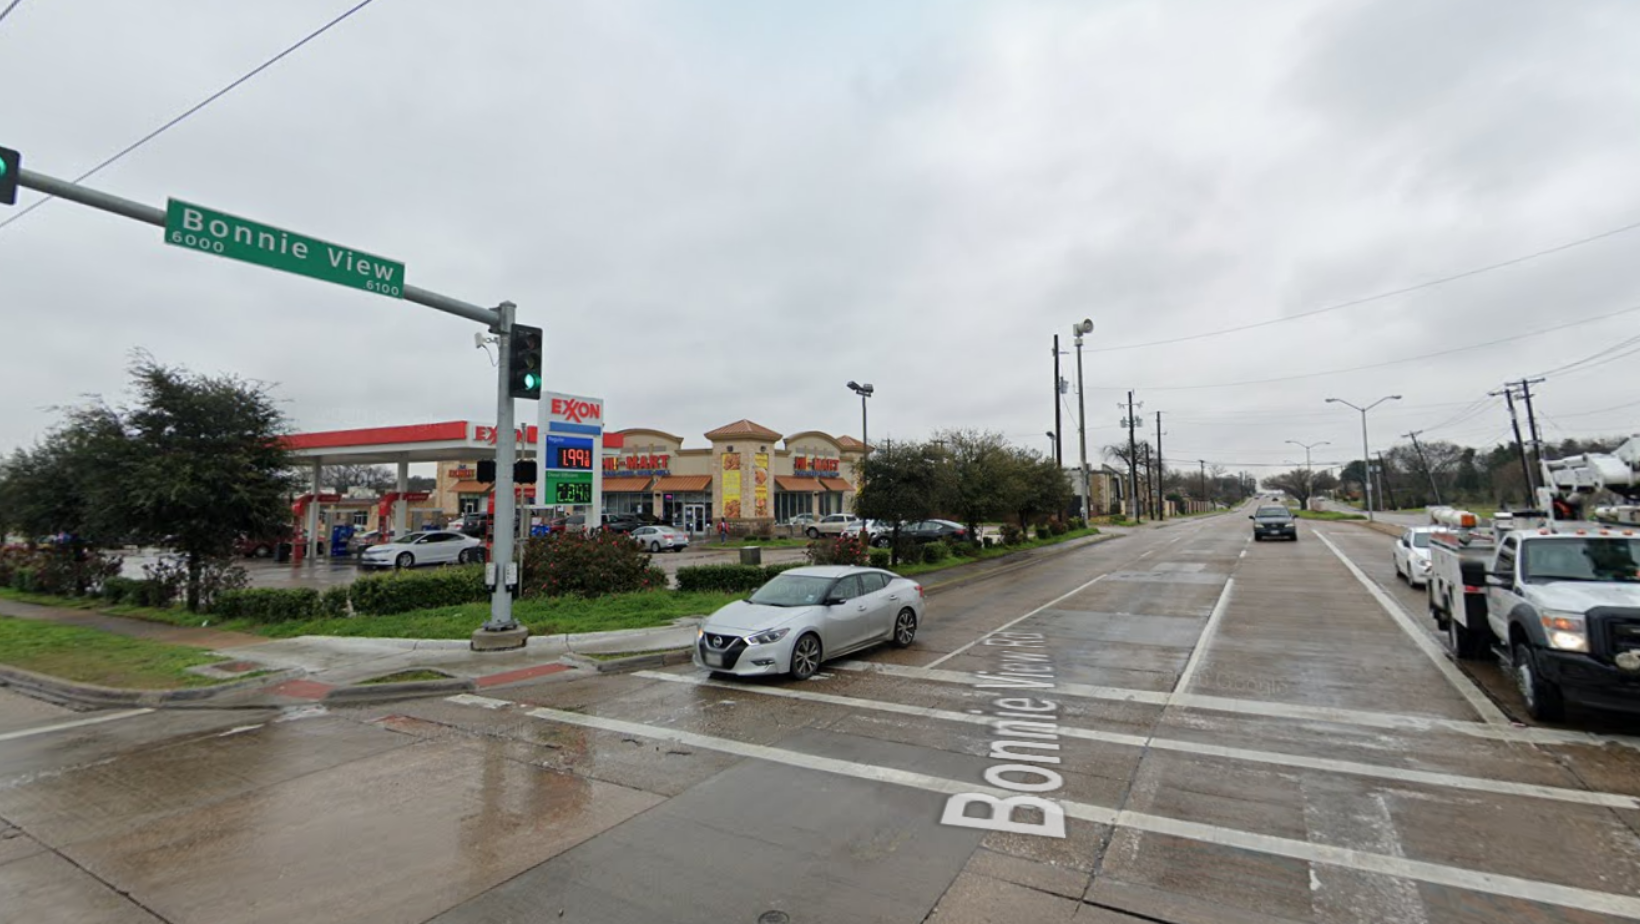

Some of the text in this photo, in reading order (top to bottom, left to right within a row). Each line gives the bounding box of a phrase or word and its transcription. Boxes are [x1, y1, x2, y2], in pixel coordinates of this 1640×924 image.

[172, 231, 225, 253] 6000
[182, 208, 395, 282] Bonnie View
[366, 281, 399, 296] 6100
[551, 398, 601, 423] EXXON
[475, 425, 527, 445] EXN
